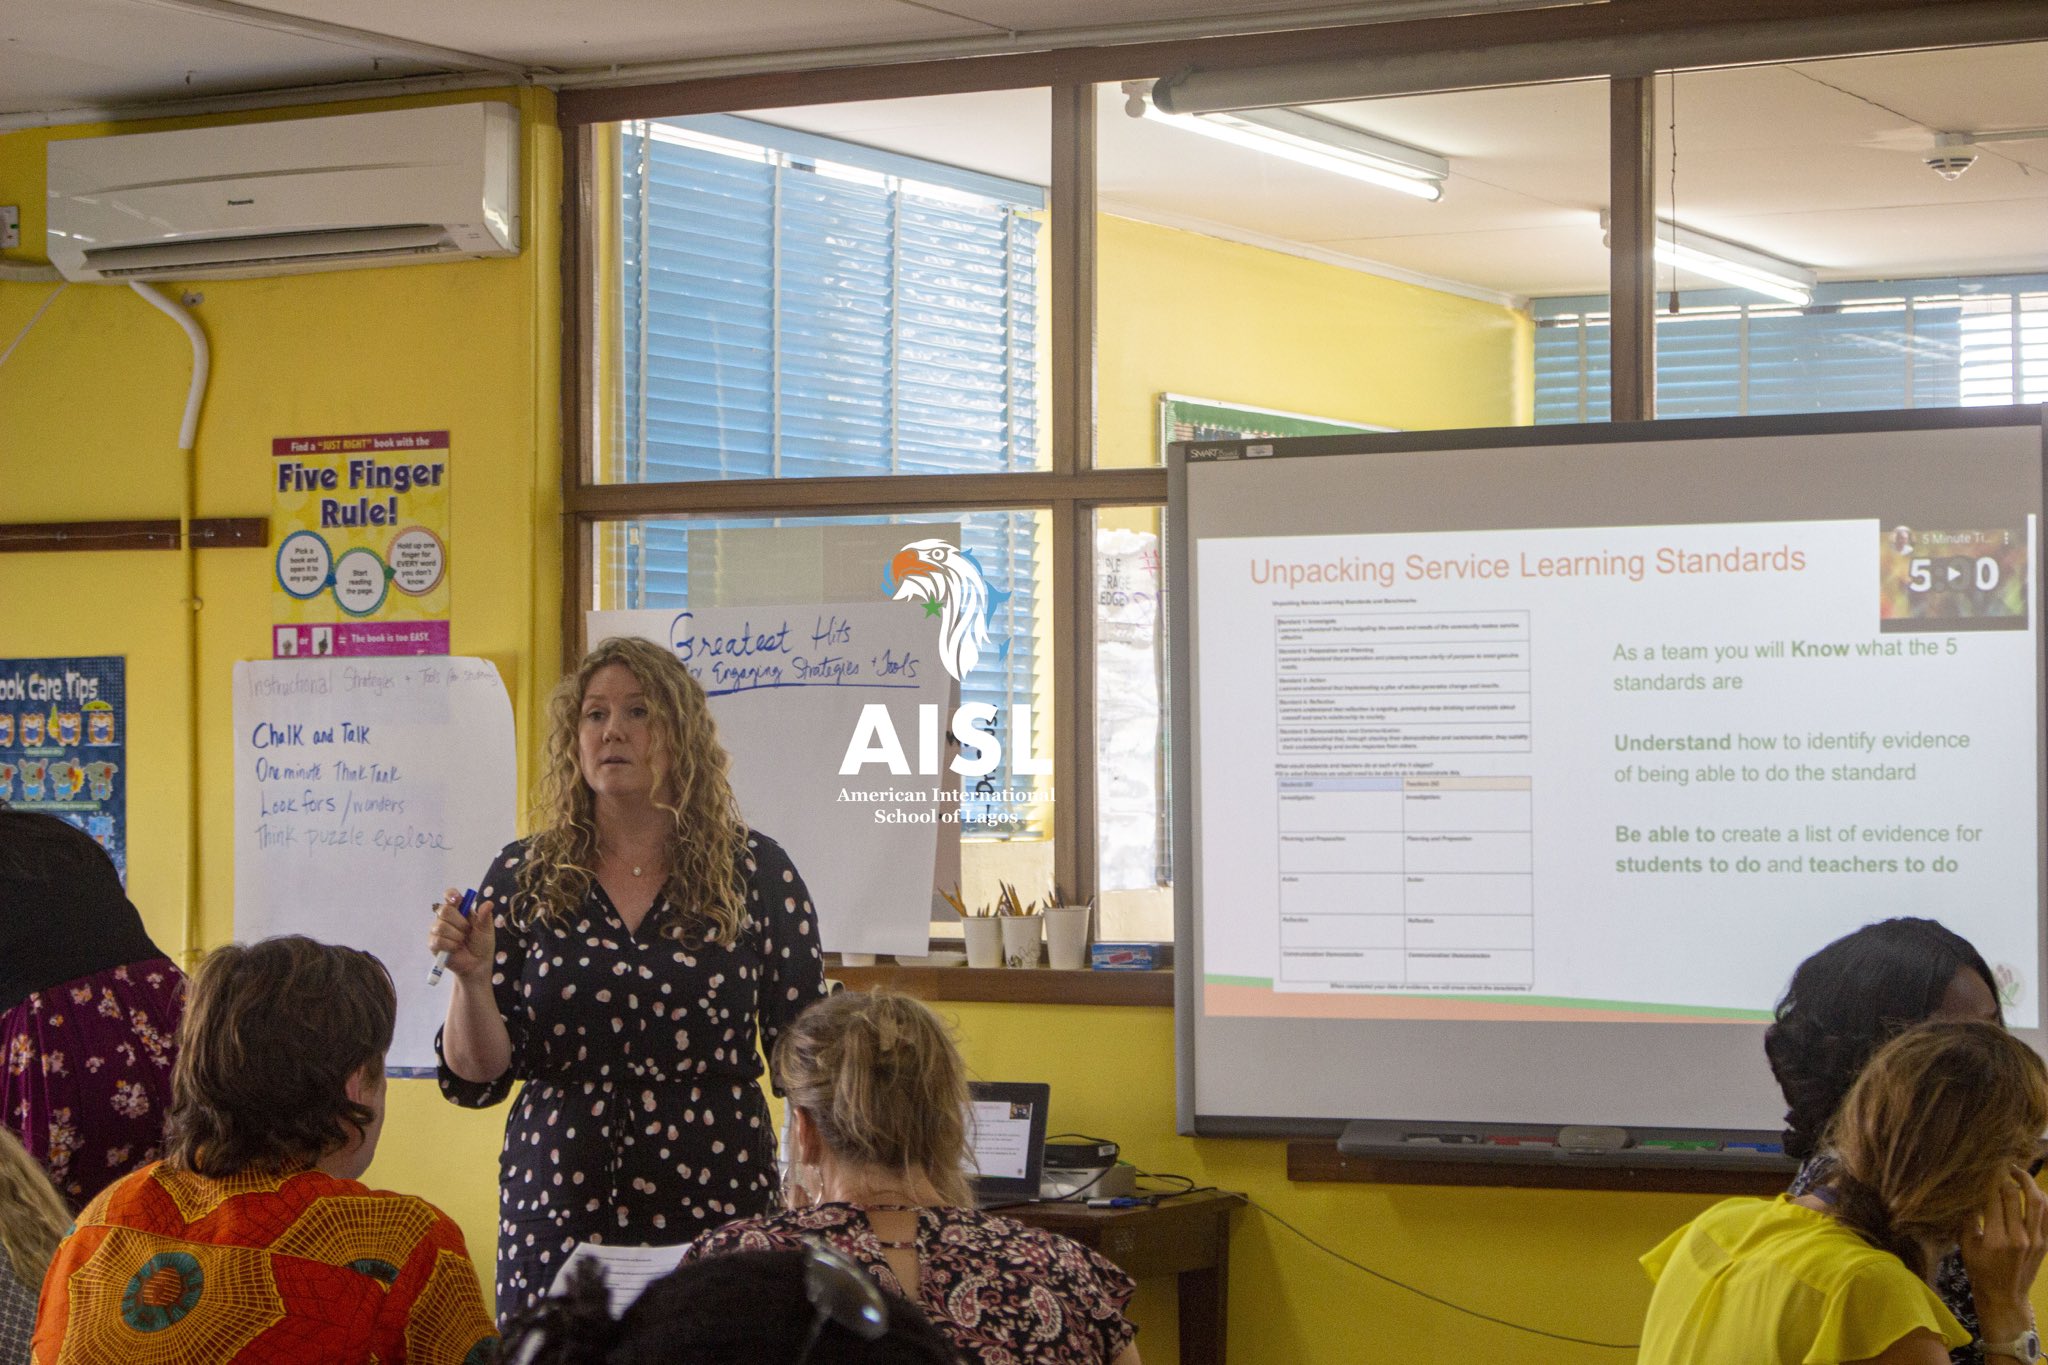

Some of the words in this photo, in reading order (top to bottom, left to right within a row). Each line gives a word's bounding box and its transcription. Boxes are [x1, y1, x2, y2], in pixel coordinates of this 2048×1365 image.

[291, 441, 308, 452] Find
[374, 438, 394, 448] book
[396, 437, 414, 447] with
[416, 436, 430, 446] the
[278, 462, 338, 492] Five
[349, 459, 444, 494] Finger
[321, 498, 397, 528] Rule!
[1922, 534, 1930, 544] 5
[1932, 532, 1970, 544] Minute
[1250, 556, 1394, 590] Unpacking
[1404, 553, 1510, 581] Service
[1520, 550, 1645, 582] Learning
[1656, 546, 1806, 576] Standards
[352, 634, 365, 643] The
[368, 634, 385, 643] book
[387, 634, 394, 642] is
[410, 632, 430, 642] EASY.
[670, 612, 792, 662] Greatest
[812, 616, 851, 650] Hits
[1612, 643, 1638, 661] As
[1644, 646, 1655, 660] a
[1661, 644, 1708, 660] team
[1714, 644, 1748, 664] you
[1754, 640, 1784, 658] will
[1791, 640, 1850, 658] Know
[1856, 639, 1903, 656] what
[1909, 638, 1939, 656] the
[1945, 638, 1958, 656] 5
[28, 672, 62, 701] Care
[65, 668, 98, 704] Tips
[712, 660, 784, 690] Engaging
[792, 656, 860, 685] Strategies
[1613, 673, 1706, 692] standards
[1712, 674, 1744, 690] are
[252, 722, 304, 748] Chalk
[313, 728, 334, 744] and
[341, 722, 370, 744] Talk
[1614, 732, 1732, 752] Understand
[1738, 732, 1778, 750] how
[1783, 734, 1801, 750] to
[1807, 731, 1876, 754] identify
[1882, 730, 1971, 750] evidence
[1614, 764, 1634, 783] of
[1637, 764, 1690, 787] being
[1695, 764, 1736, 782] able
[1742, 764, 1760, 782] to
[1765, 764, 1790, 782] do
[1795, 763, 1826, 782] the
[1831, 762, 1917, 782] standard
[306, 824, 365, 855] puzzle
[1615, 824, 1642, 843] Be
[1648, 824, 1690, 843] able
[1696, 825, 1716, 843] to
[1721, 825, 1782, 843] create
[1786, 828, 1800, 843] a
[1804, 824, 1832, 842] list
[1838, 824, 1858, 842] of
[1862, 824, 1950, 842] evidence
[1956, 824, 1983, 842] for
[1615, 855, 1704, 874] students
[1708, 856, 1730, 874] to
[1735, 855, 1762, 874] do
[1766, 855, 1802, 874] and
[1808, 855, 1898, 874] teachers
[1904, 856, 1926, 873] to
[1932, 855, 1958, 873] do
